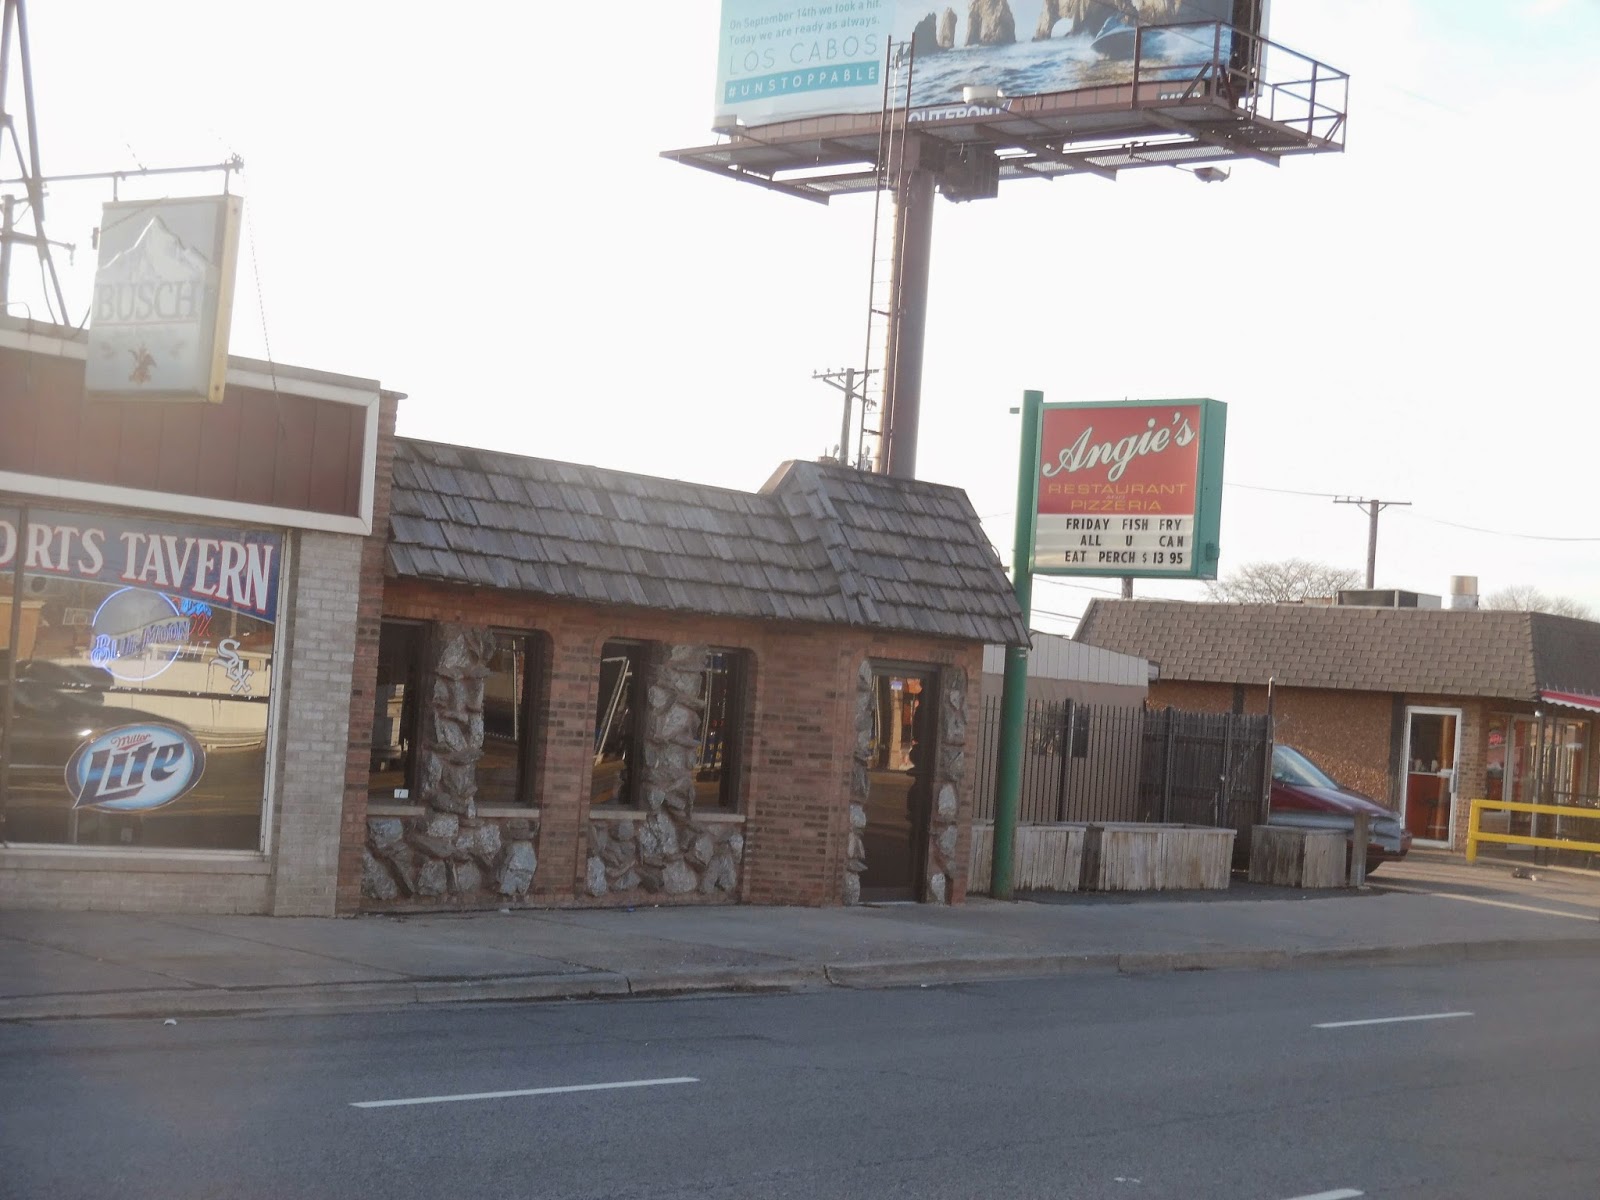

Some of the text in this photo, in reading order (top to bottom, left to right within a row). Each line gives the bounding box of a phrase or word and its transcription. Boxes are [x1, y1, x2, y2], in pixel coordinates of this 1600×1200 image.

[729, 15, 880, 46] Today we are ready as always.
[730, 19, 742, 30] On
[744, 11, 794, 29] September
[797, 6, 817, 19] 14th
[819, 5, 832, 15] we
[835, 1, 856, 14] took
[729, 33, 877, 75] LOS CABOS
[727, 66, 876, 98] #UNSTOPPABLE
[94, 280, 201, 321] BUSCH
[1042, 411, 1196, 482] Angie's
[1048, 483, 1188, 495] RESTAURANT
[1070, 500, 1162, 511] PIZZERIA
[1066, 518, 1182, 531] FRIDAY FISH FRY
[1080, 534, 1184, 548] ALL U CAN
[1065, 550, 1087, 563] EAT
[1098, 551, 1136, 564] PERCH
[119, 531, 274, 615] TAVERN
[111, 733, 152, 748] Miller
[73, 740, 186, 810] Lite
